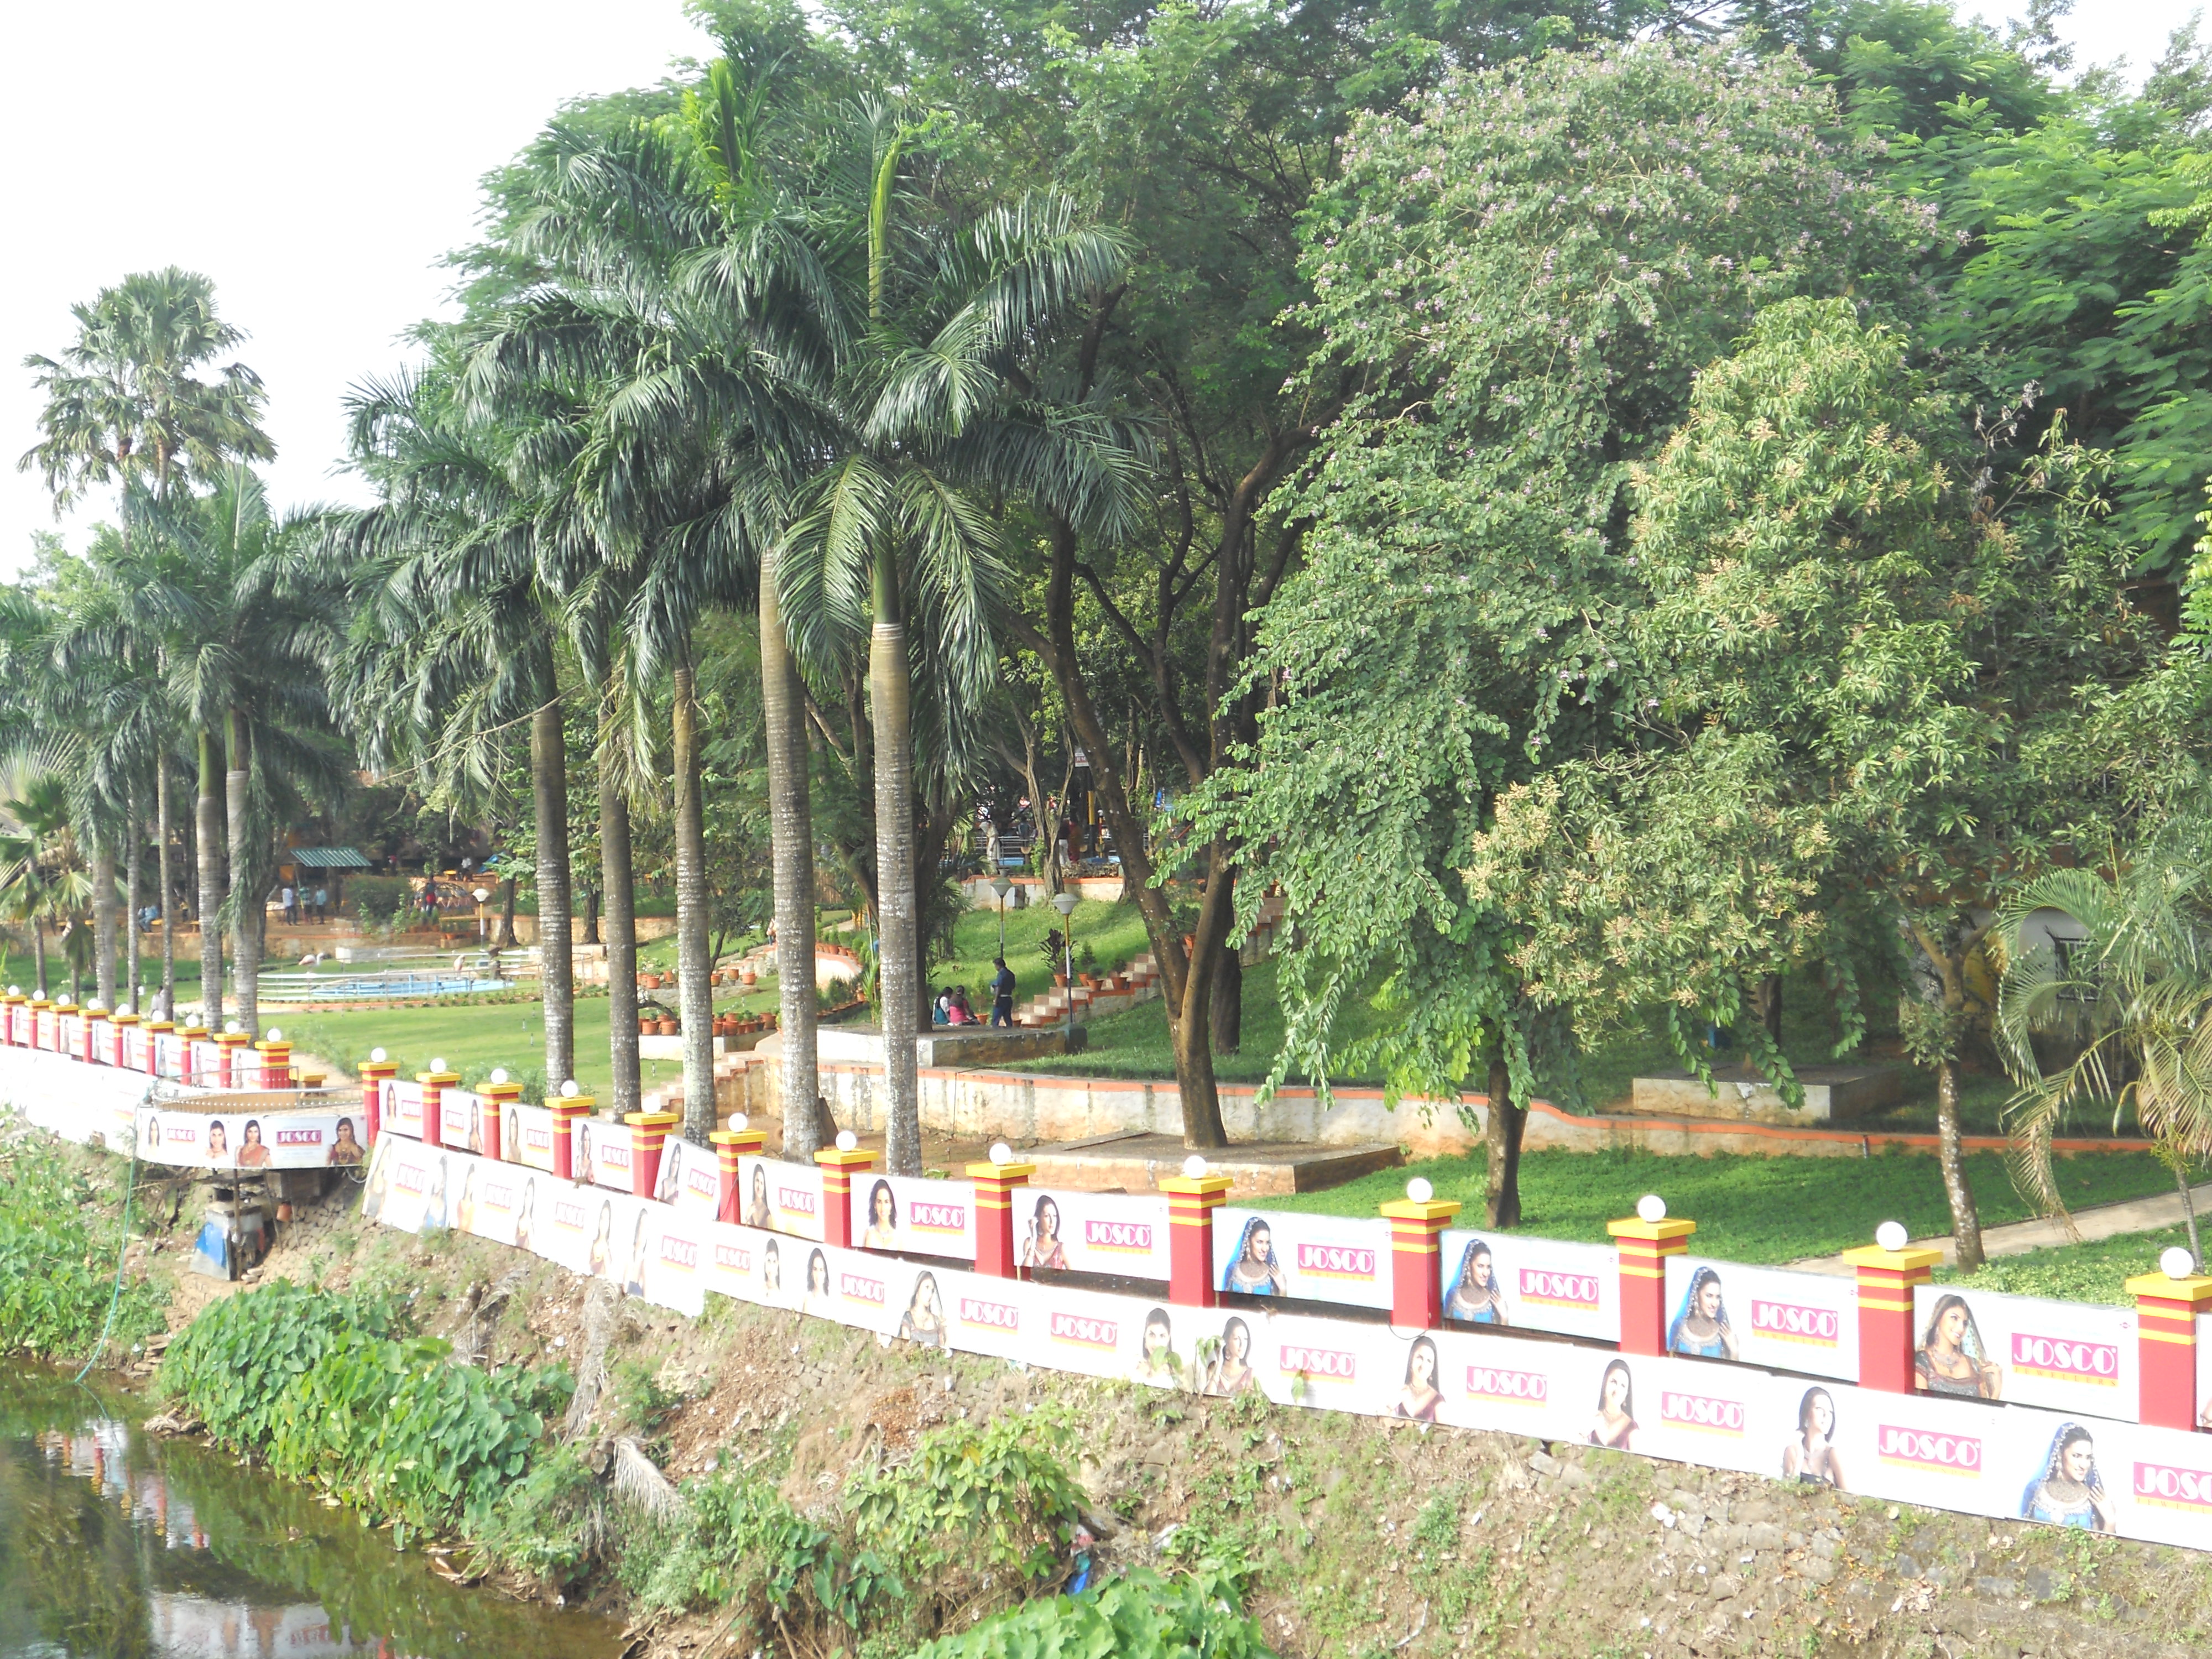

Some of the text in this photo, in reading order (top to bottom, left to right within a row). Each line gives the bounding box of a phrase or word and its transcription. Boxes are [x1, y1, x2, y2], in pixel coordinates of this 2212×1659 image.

[168, 1129, 195, 1140] JOSCO
[278, 1131, 321, 1143] JOSCO
[688, 1171, 716, 1196] JOSCO
[779, 1189, 814, 1212] JOSCO
[911, 1204, 964, 1227] JOSCO
[1087, 1223, 1150, 1246] JOSCO
[662, 1238, 696, 1266] JOSCO
[717, 1246, 750, 1269] JOSCO
[1300, 1246, 1373, 1272] JOSCO
[842, 1276, 884, 1301] JOSCO
[1521, 1271, 1598, 1301] JOSCO
[961, 1301, 1018, 1327] JOSCO
[1753, 1304, 1837, 1337] JOSCO
[1052, 1316, 1116, 1343] JOSCO
[1281, 1347, 1354, 1376] JOSCO
[2014, 1338, 2116, 1374] JOSCO
[1468, 1369, 1546, 1399] JOSCO
[2014, 1366, 2116, 1386] JEWELLERS
[1663, 1394, 1743, 1428] JOSCO
[1880, 1430, 1979, 1466] JOSCO
